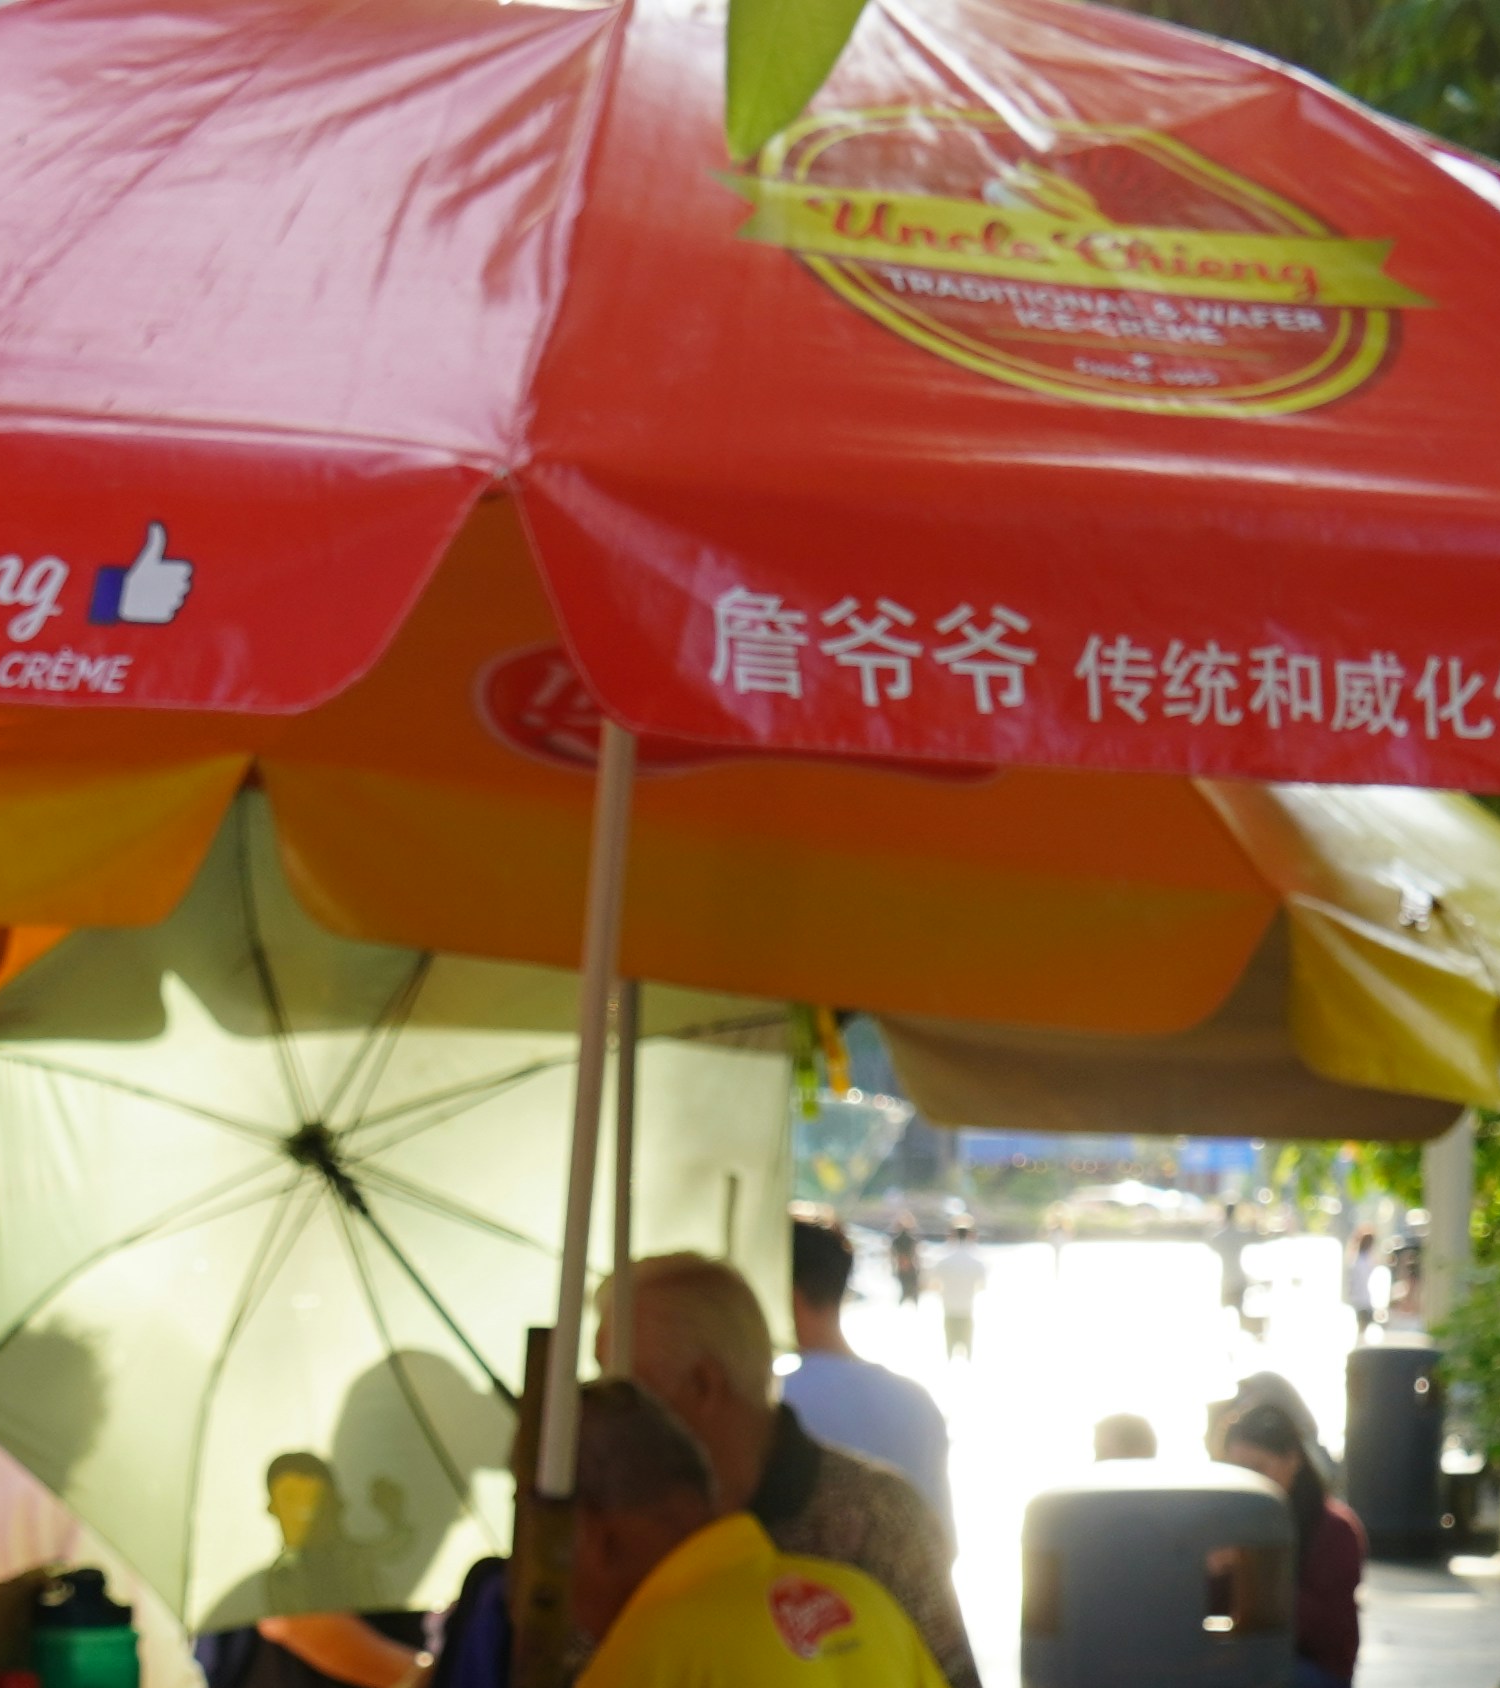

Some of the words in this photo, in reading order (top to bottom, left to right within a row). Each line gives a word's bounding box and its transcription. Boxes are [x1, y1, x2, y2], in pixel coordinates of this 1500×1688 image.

[805, 196, 1053, 266] Uncle
[1051, 228, 1319, 303] Chieng
[711, 586, 1038, 715] 詹爷爷
